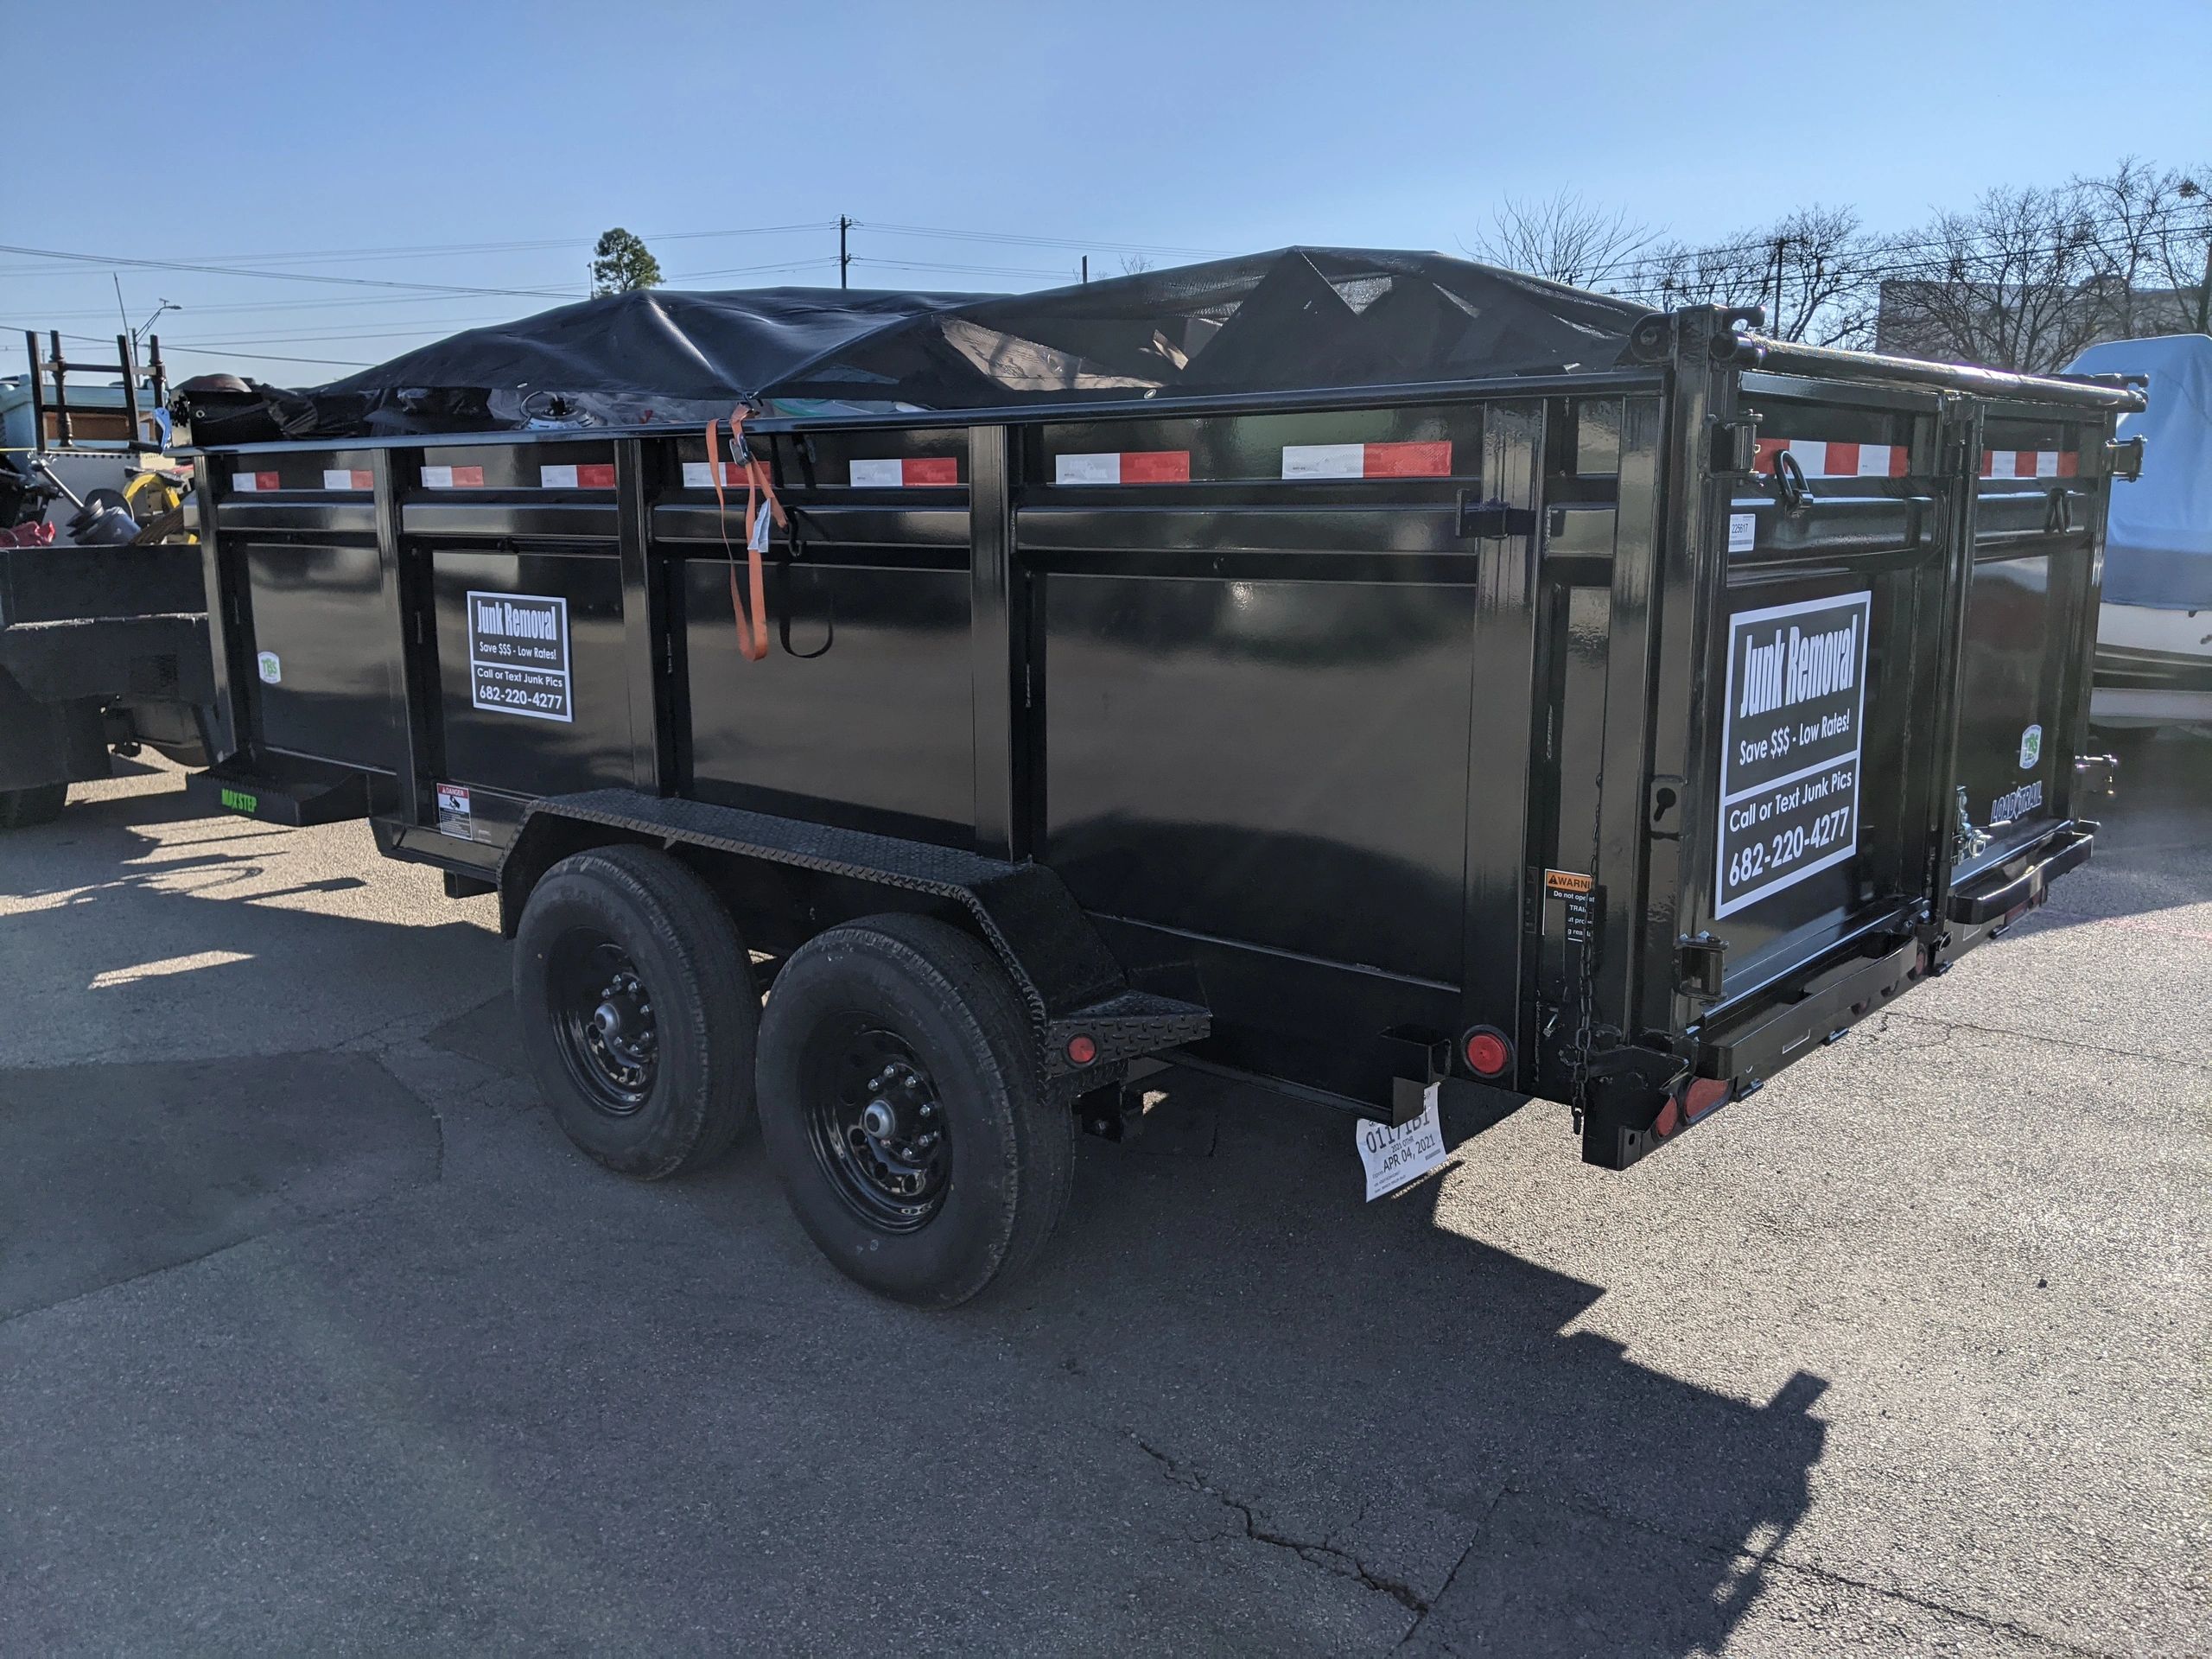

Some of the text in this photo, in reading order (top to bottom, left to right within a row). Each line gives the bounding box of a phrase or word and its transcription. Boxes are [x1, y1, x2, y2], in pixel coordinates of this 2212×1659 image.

[477, 601, 557, 640] Junk Removal
[480, 641, 497, 653] Save
[499, 643, 512, 657] $$$
[518, 646, 532, 657] Low
[534, 647, 556, 660] Rates!
[1739, 614, 1858, 718] Junk Removal
[477, 668, 563, 687] Call or Text Junk Pics
[480, 685, 563, 709] 682-220-4277
[1739, 740, 1767, 766] Save
[1770, 726, 1790, 759] $$$
[1799, 723, 1820, 746] Low
[1821, 709, 1850, 738] Rates!
[1729, 771, 1852, 832] Call or Text Junk Pics
[1729, 806, 1849, 887] 682-220-4277
[1558, 876, 1592, 889] WARNI
[1383, 1134, 1435, 1173] APR 04, 2021
[1391, 1142, 1402, 1153] 2021
